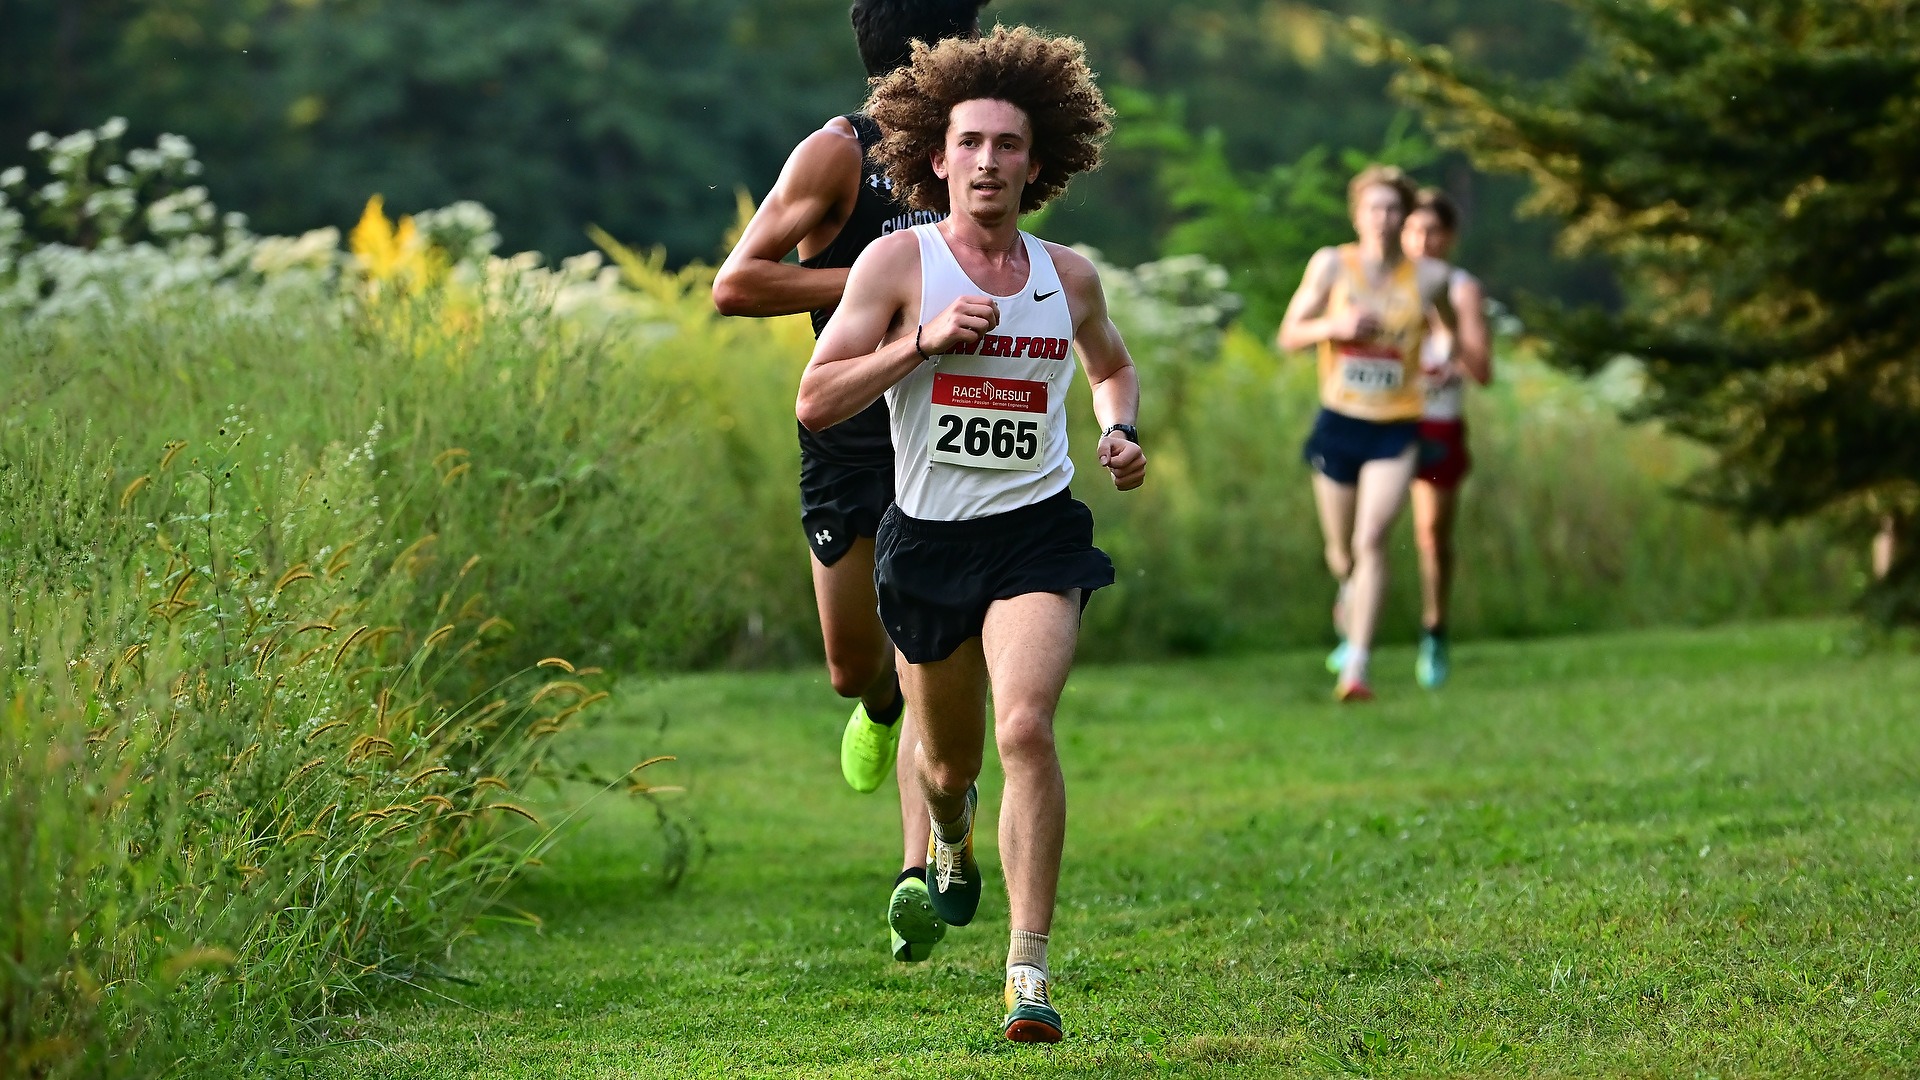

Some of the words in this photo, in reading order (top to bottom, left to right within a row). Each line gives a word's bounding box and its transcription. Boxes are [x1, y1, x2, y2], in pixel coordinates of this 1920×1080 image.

[952, 385, 981, 398] RACE
[995, 389, 1031, 402] RESULT
[935, 414, 1038, 460] 2665
